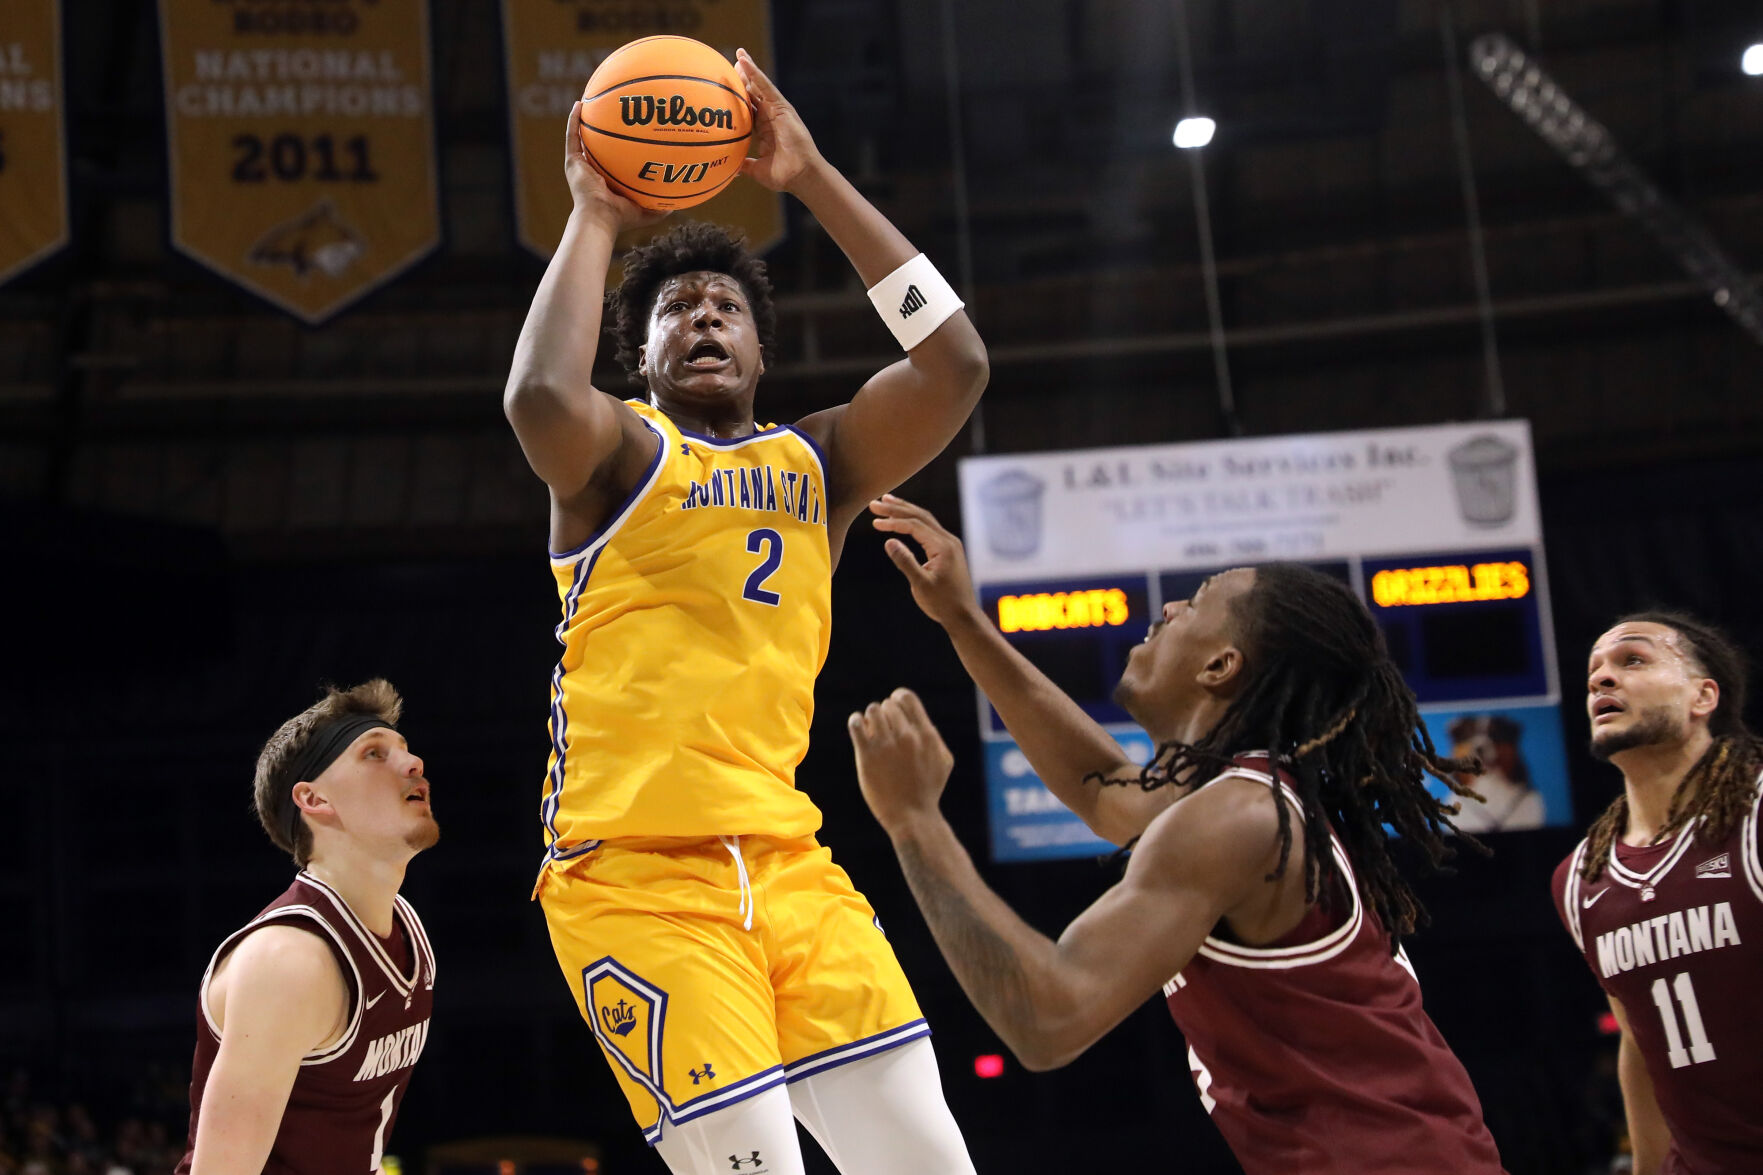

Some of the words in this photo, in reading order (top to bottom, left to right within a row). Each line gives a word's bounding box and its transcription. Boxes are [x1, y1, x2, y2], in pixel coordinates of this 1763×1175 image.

[194, 49, 403, 80] NATIONAL
[176, 84, 422, 117] CHAMPIONS
[619, 94, 733, 130] Wilson
[232, 134, 377, 182] 2011
[637, 161, 710, 184] EVO
[709, 156, 729, 169] NXT
[681, 465, 778, 511] MONTANA
[742, 527, 785, 607] 2
[1371, 560, 1530, 607] GRIZZLIES
[997, 588, 1129, 633] BOBCATS
[1596, 901, 1742, 978] MONTANA
[602, 999, 637, 1033] Cats
[1651, 971, 1717, 1069] 11
[370, 1084, 399, 1172] 1
